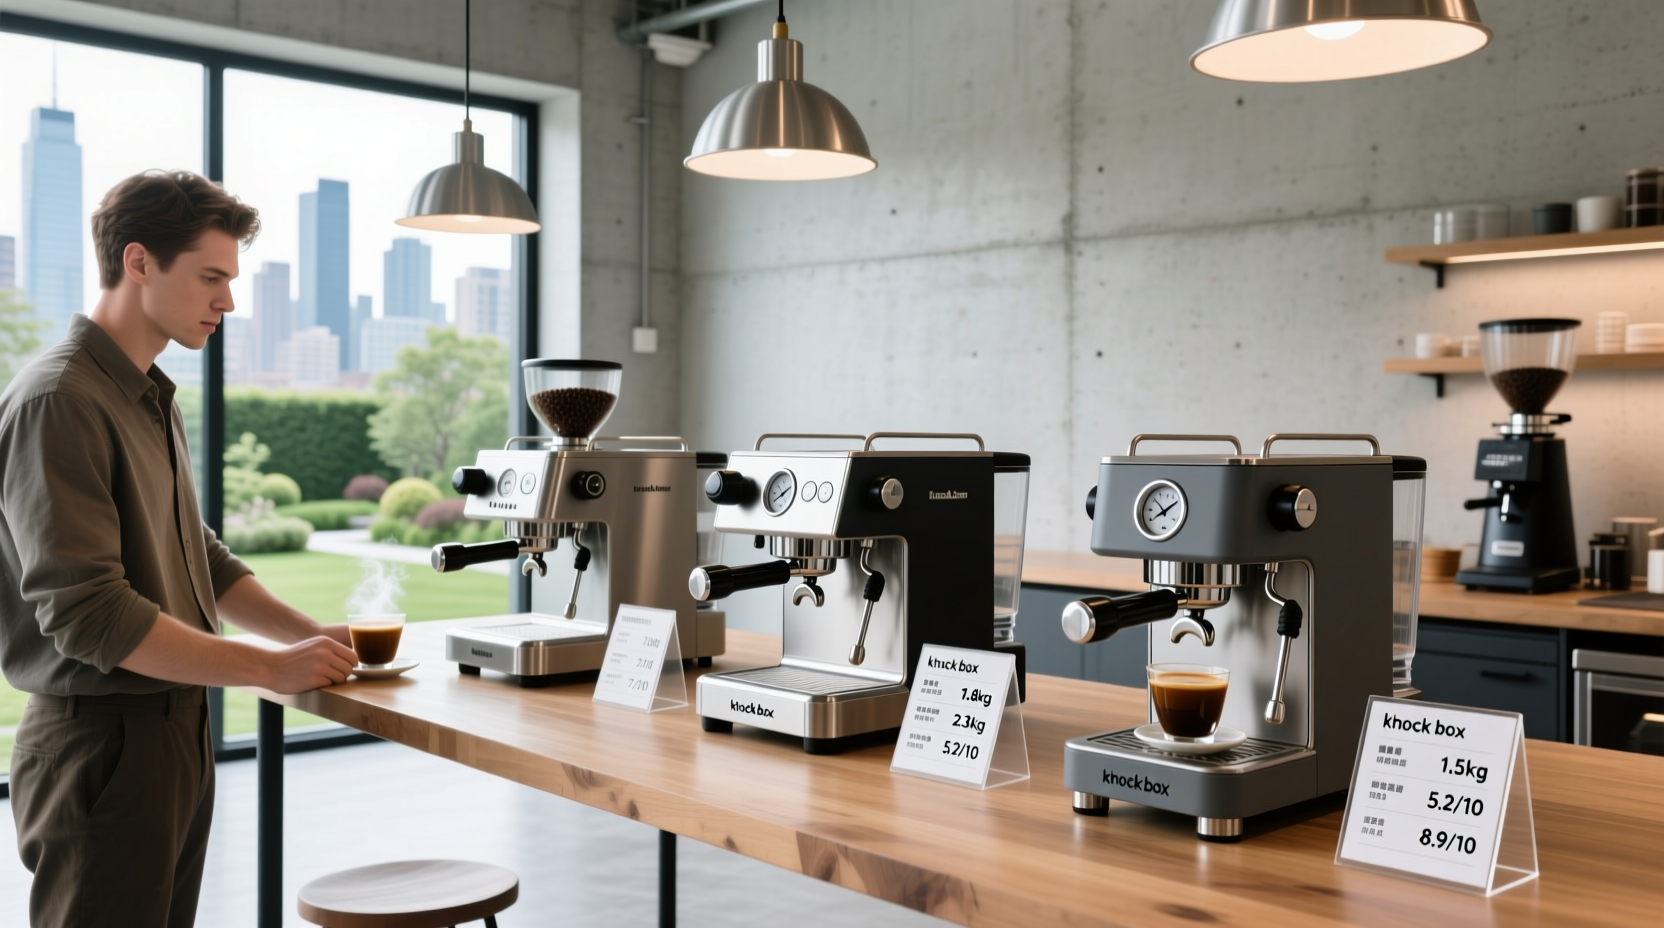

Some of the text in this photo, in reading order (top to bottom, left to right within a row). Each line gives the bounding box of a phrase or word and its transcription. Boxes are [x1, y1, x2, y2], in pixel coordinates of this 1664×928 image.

[958, 659, 979, 674] box
[1383, 712, 1466, 739] khock box
[1441, 756, 1489, 784] 1.5kg
[1143, 775, 1170, 797] box
[1426, 790, 1484, 817] 5.2/10
[1418, 827, 1477, 855] 8.9/10
